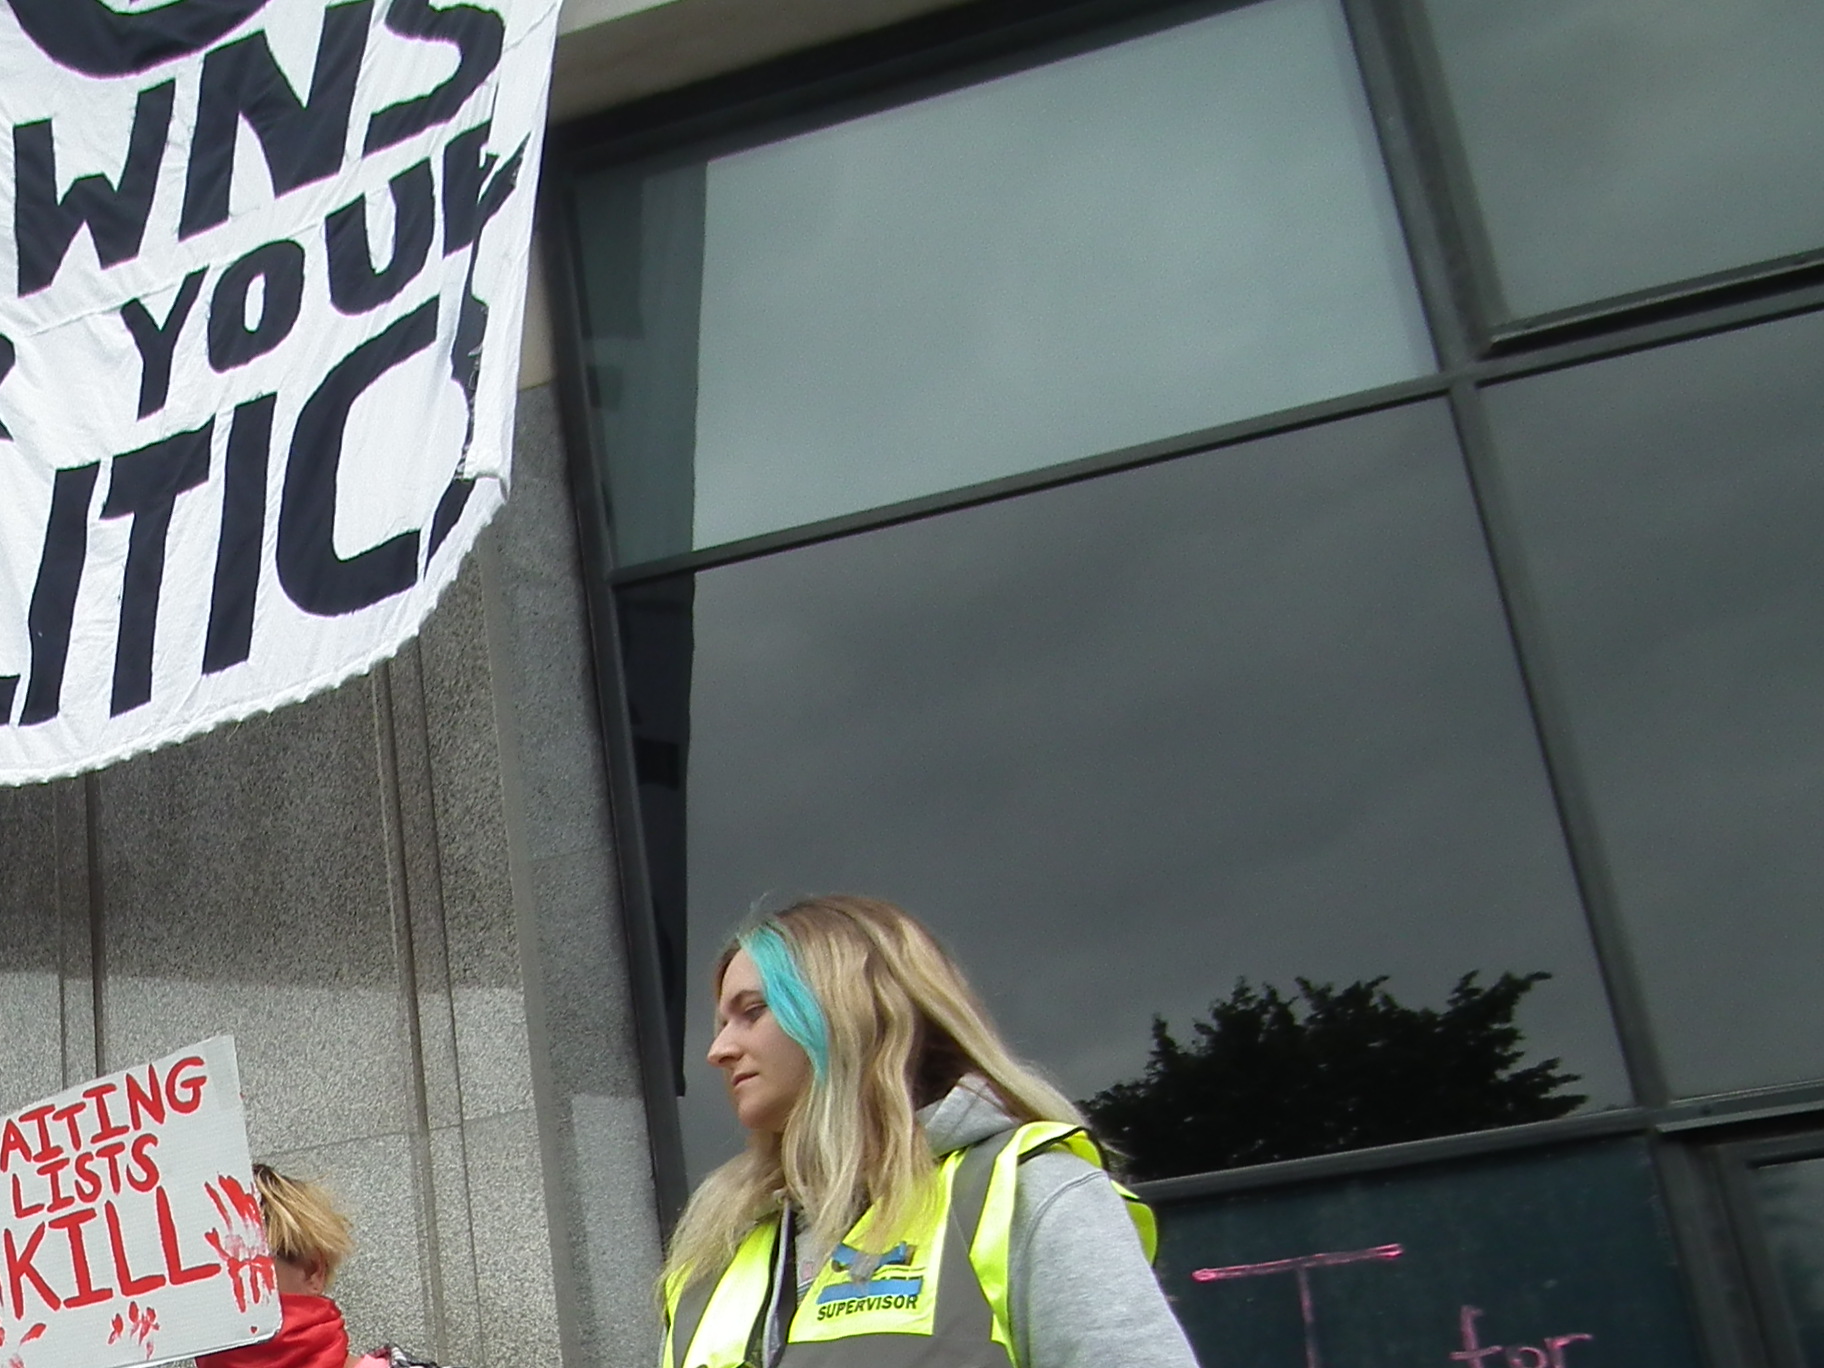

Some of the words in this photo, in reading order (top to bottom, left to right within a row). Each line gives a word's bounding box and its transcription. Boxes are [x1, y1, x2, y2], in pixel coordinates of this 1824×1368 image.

[12, 1133, 160, 1219] LISTS
[3, 1186, 221, 1320] KILL
[816, 1294, 919, 1322] SUPERVISOR
